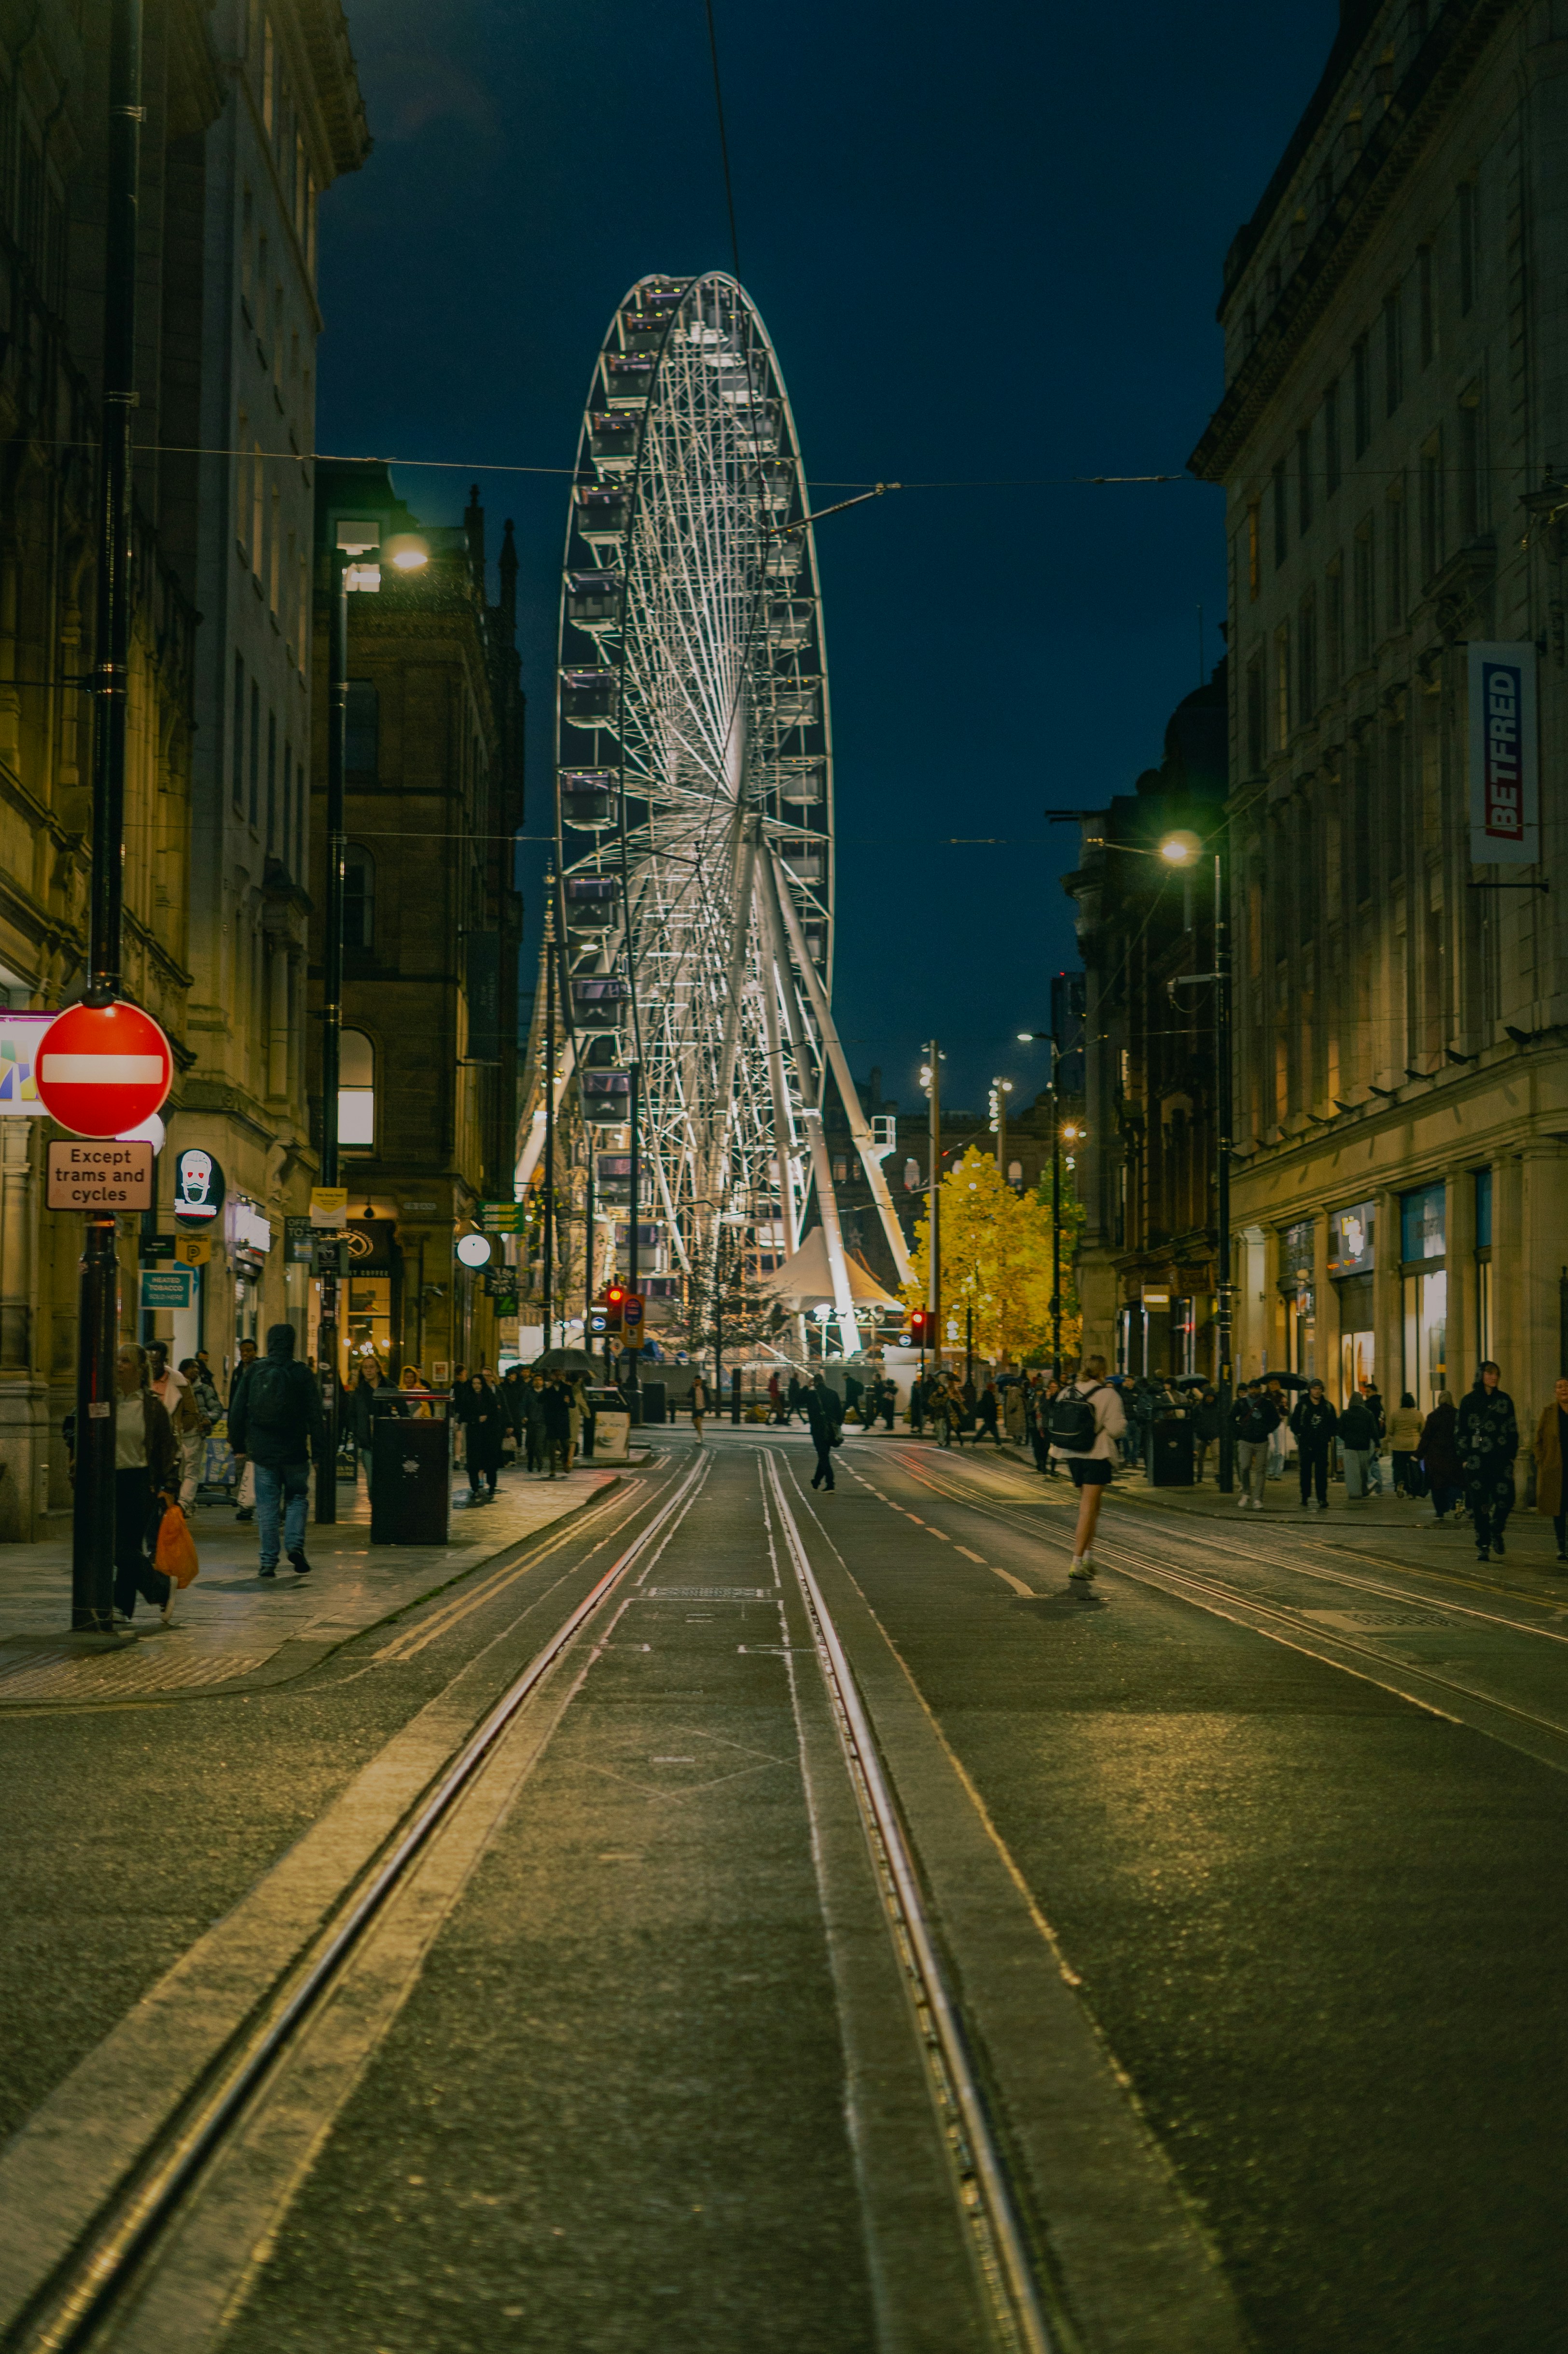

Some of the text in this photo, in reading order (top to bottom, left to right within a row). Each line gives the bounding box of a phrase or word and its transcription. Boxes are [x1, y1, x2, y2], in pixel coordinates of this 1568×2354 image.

[1489, 671, 1517, 833] BETFRED
[71, 1149, 131, 1165] Except
[56, 1168, 144, 1182] trams and
[73, 1187, 126, 1203] cycles
